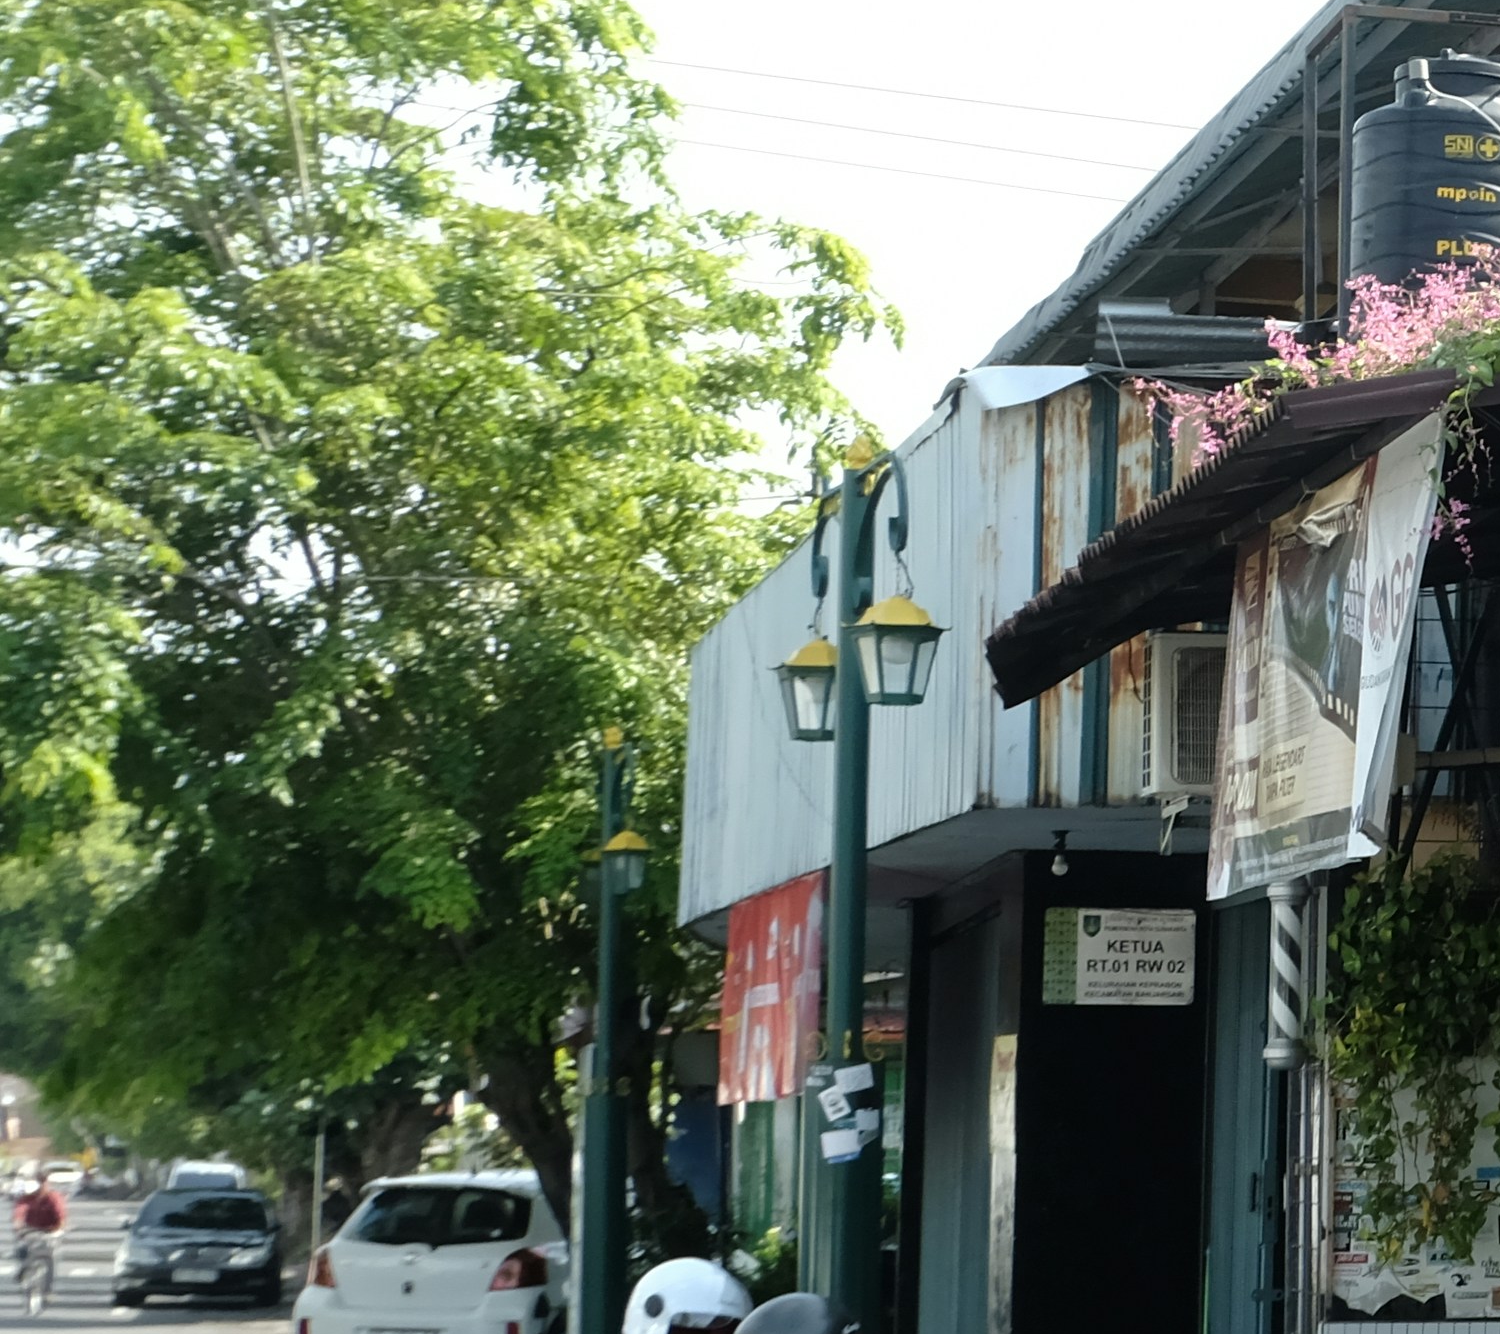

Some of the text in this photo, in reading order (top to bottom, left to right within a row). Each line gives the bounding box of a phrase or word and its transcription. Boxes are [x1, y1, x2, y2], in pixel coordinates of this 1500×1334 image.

[1107, 940, 1164, 953] KETUA
[1086, 959, 1185, 973] RT.01 RW 02
